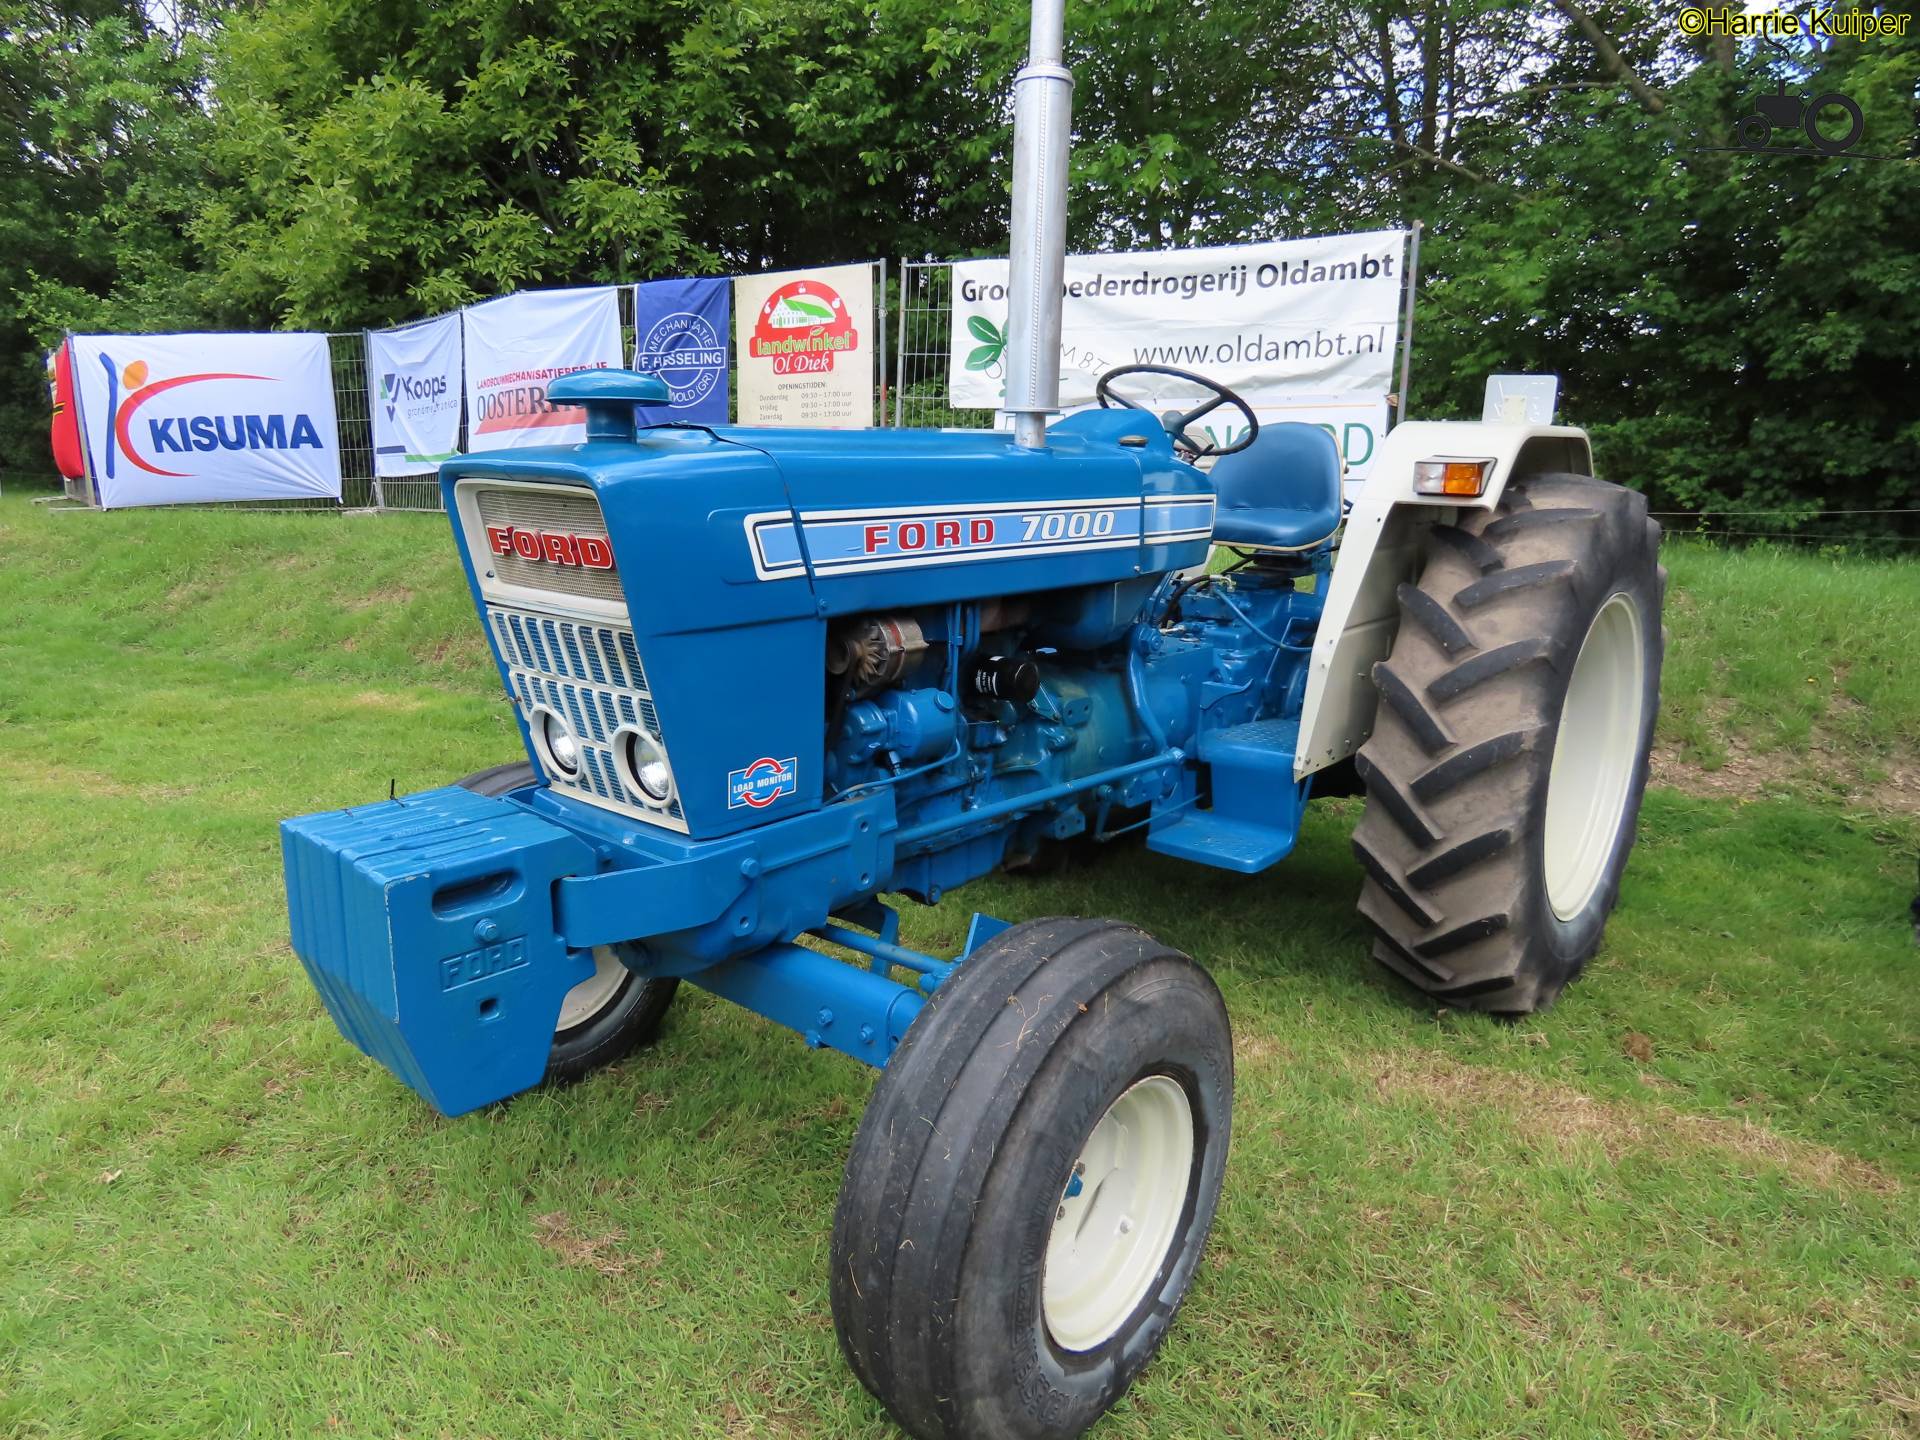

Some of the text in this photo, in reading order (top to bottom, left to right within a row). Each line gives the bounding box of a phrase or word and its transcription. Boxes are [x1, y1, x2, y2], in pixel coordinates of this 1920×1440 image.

[1256, 253, 1394, 289] Oldambt
[641, 352, 722, 369] F. HESSELING
[757, 330, 851, 356] landwinkel
[1133, 326, 1385, 365] www.oldambt.nl
[774, 350, 833, 374] Ol Diek
[402, 375, 446, 403] Koops
[149, 413, 323, 453] KISUMA
[486, 526, 616, 570] FORD
[864, 511, 1115, 553] FORD 7000
[733, 772, 792, 793] LOAD MONITOR
[441, 938, 528, 989] FORD
